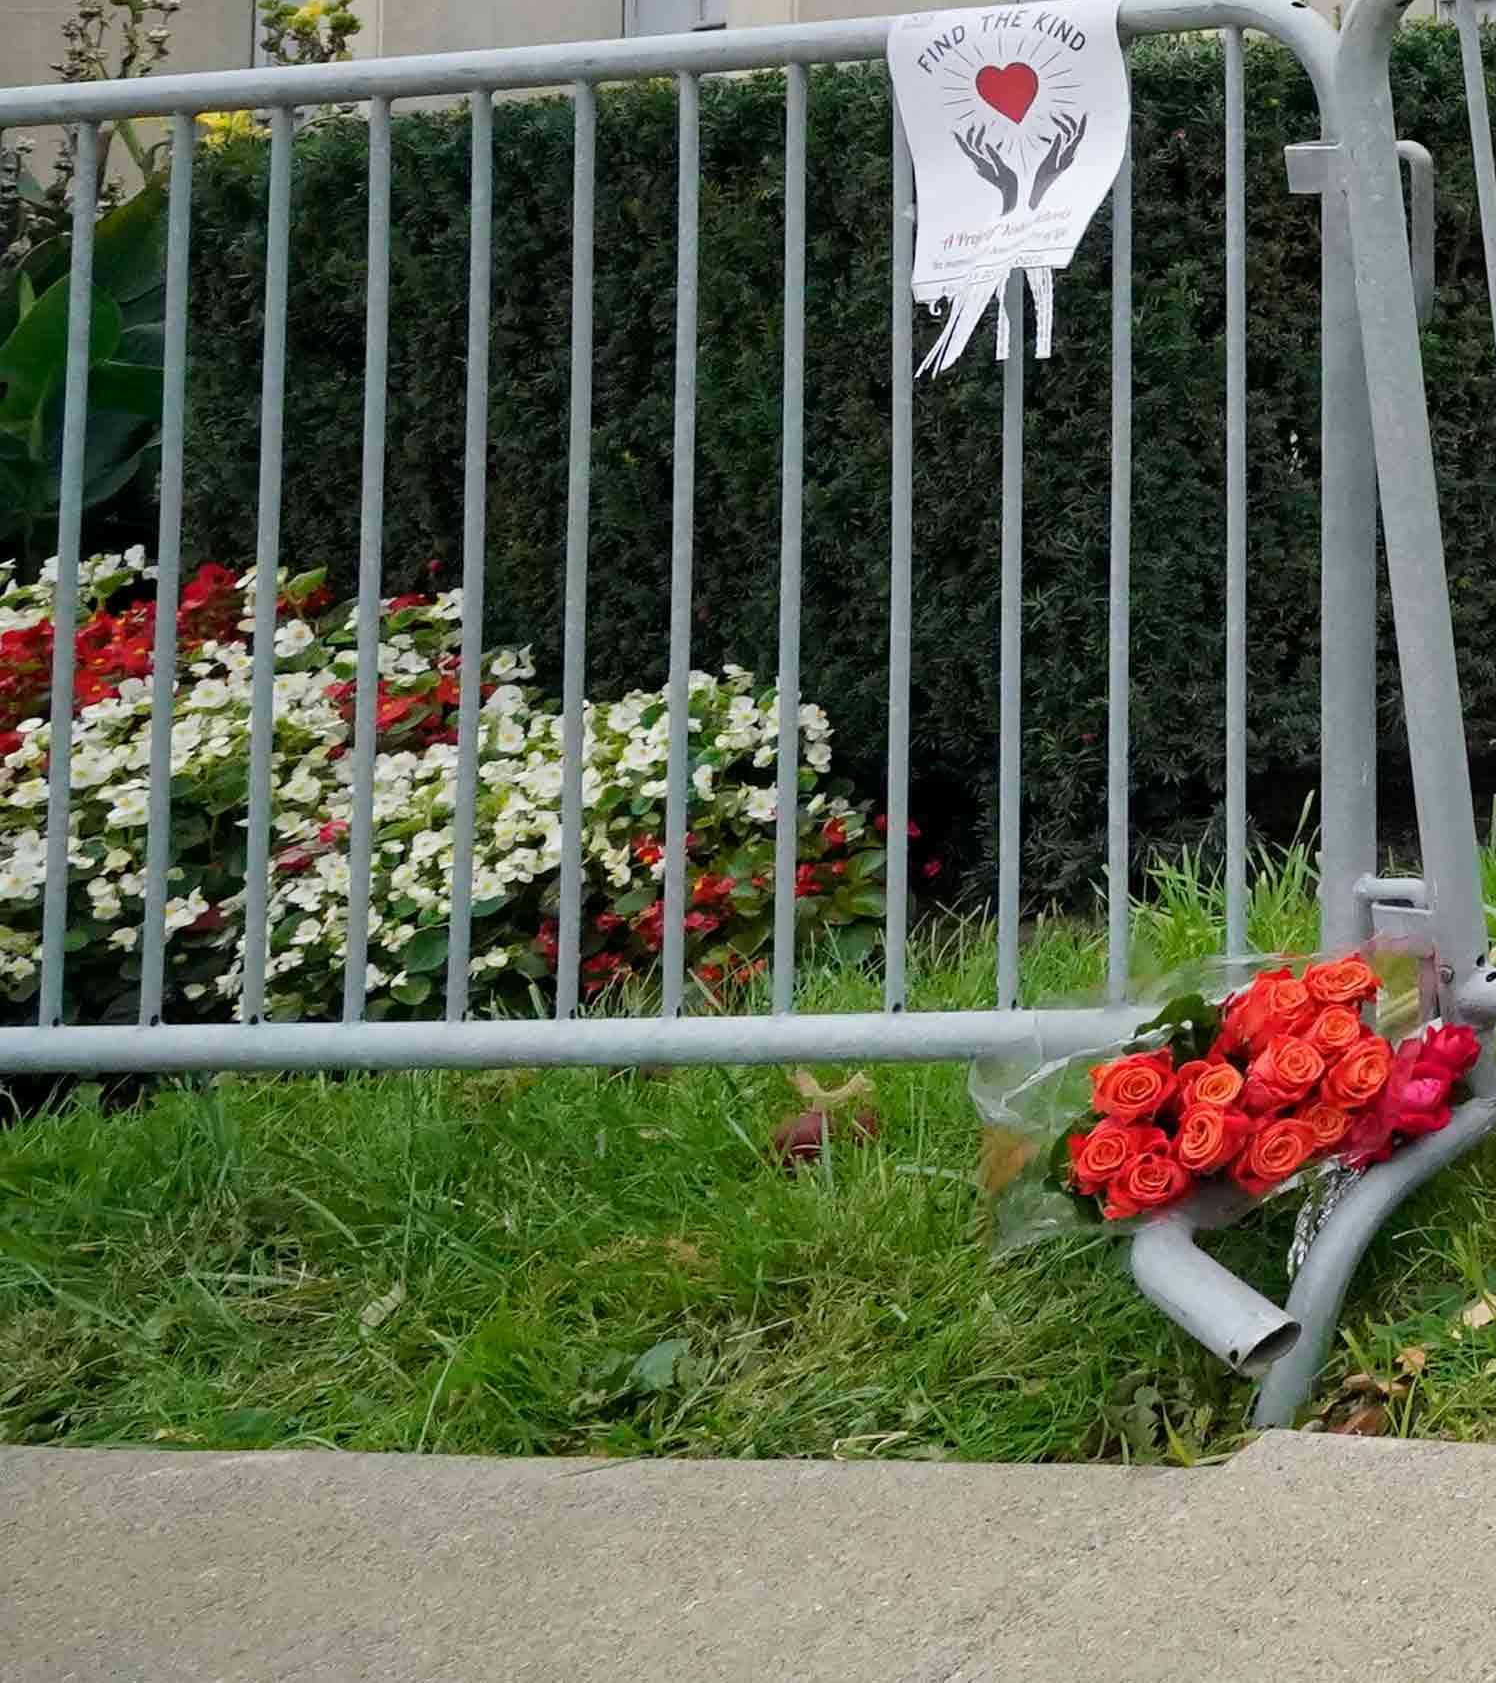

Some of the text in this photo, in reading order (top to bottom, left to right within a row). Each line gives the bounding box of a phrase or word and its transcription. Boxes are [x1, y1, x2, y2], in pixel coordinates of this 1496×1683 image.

[916, 9, 1087, 75] FIND THE KIND
